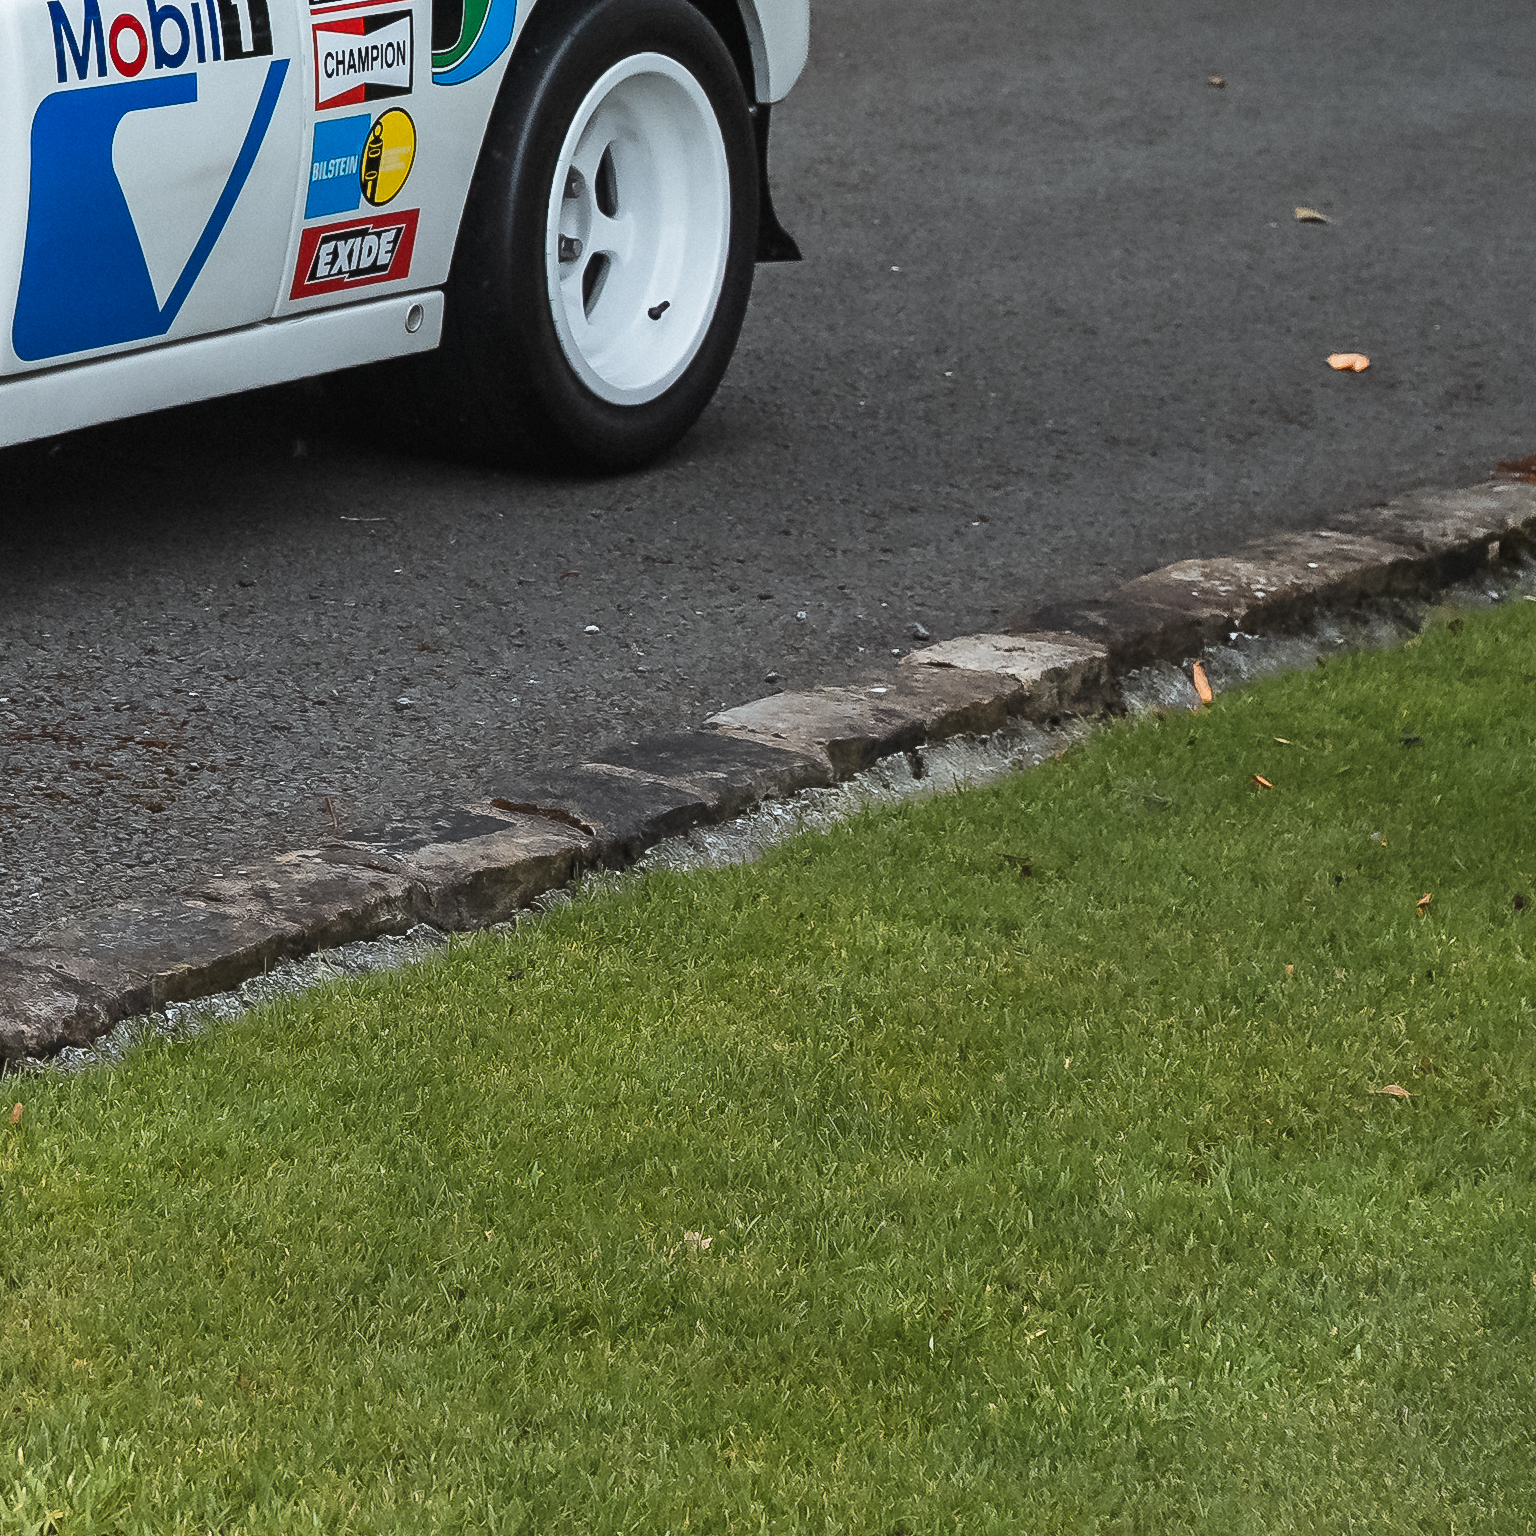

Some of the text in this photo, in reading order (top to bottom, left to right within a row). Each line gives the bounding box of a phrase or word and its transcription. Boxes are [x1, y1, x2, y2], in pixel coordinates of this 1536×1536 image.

[323, 40, 407, 78] CHAMPION
[312, 155, 358, 182] BILSTEIN
[316, 225, 397, 279] EXIDE
